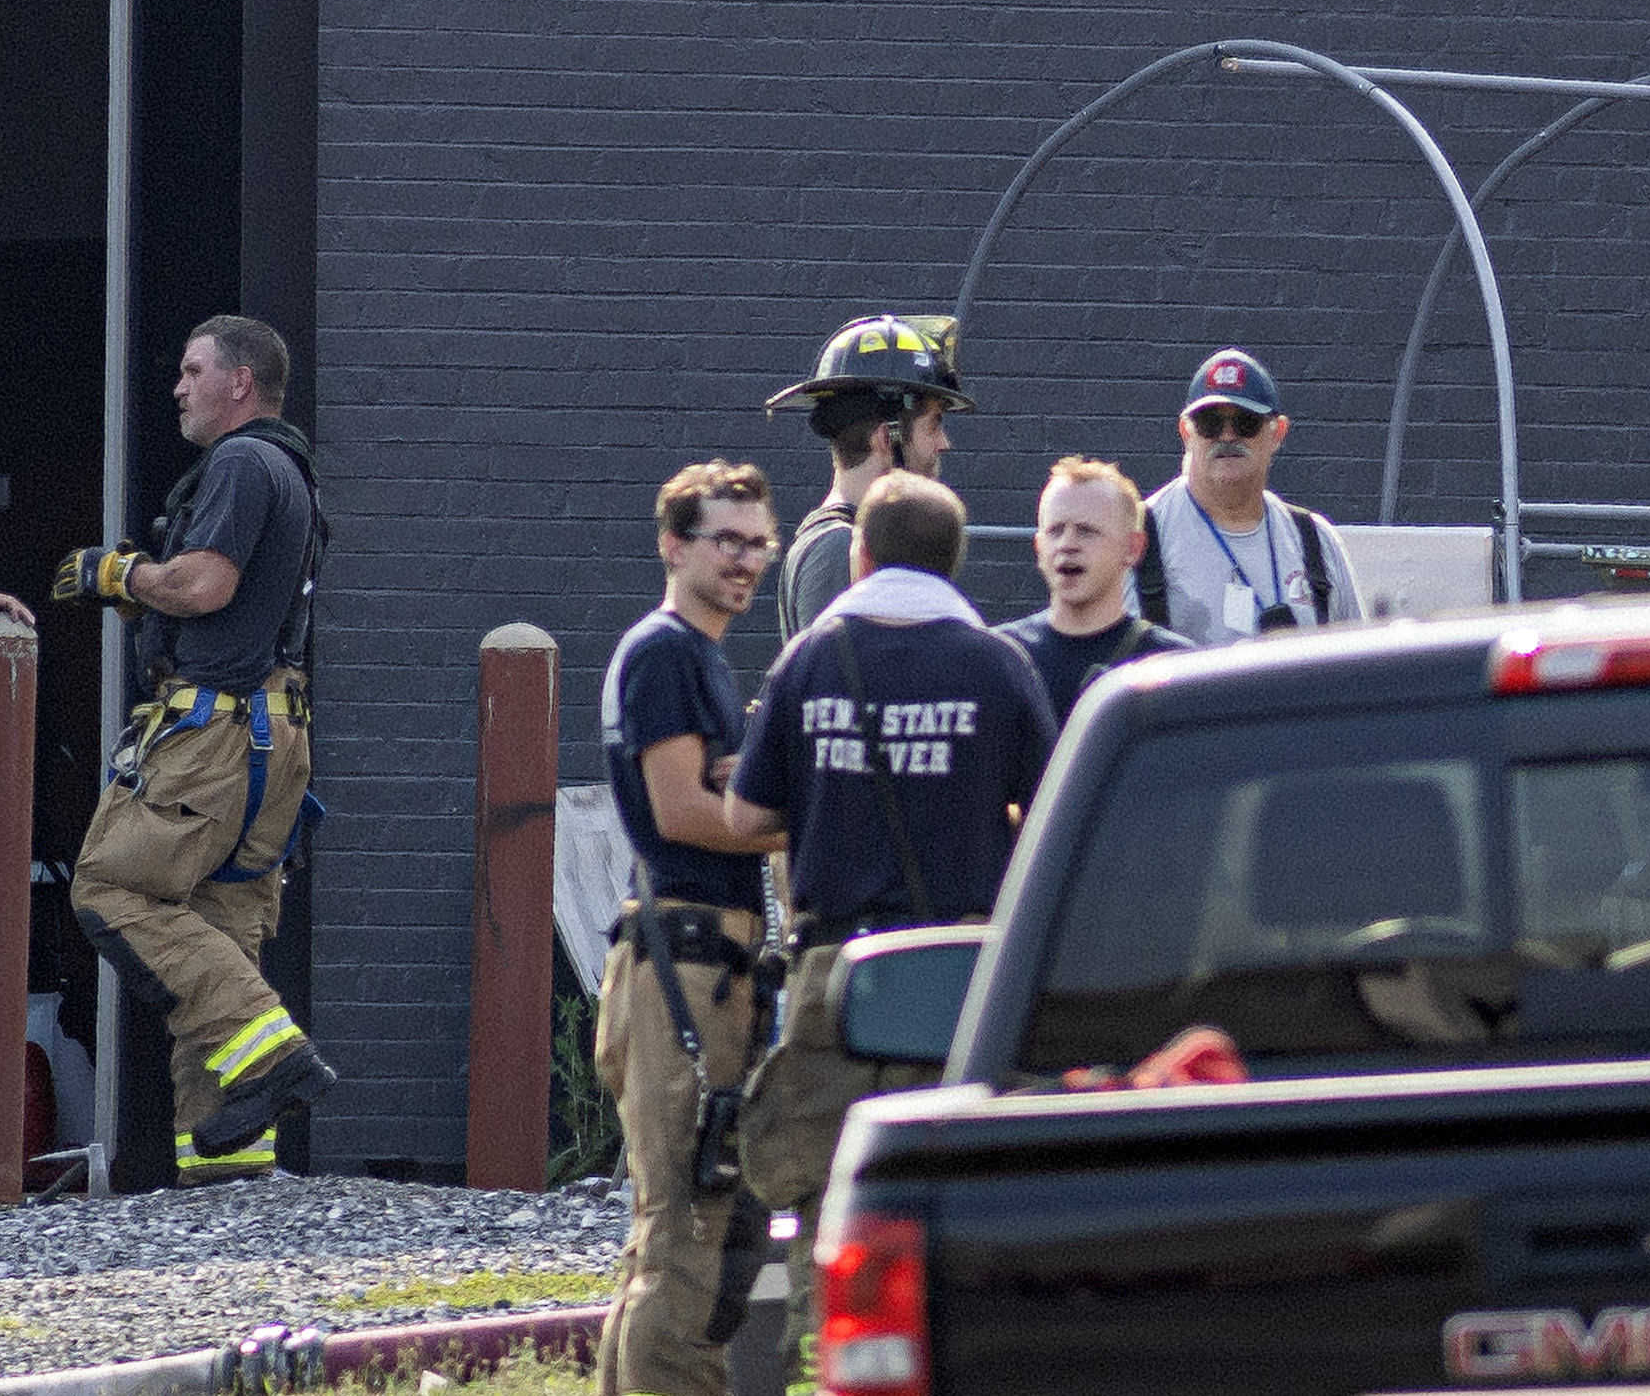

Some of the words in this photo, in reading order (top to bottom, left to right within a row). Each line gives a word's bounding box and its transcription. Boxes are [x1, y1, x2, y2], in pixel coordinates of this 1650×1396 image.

[802, 697, 878, 734] PEN
[881, 701, 979, 737] STATE
[814, 738, 950, 774] FORVER
